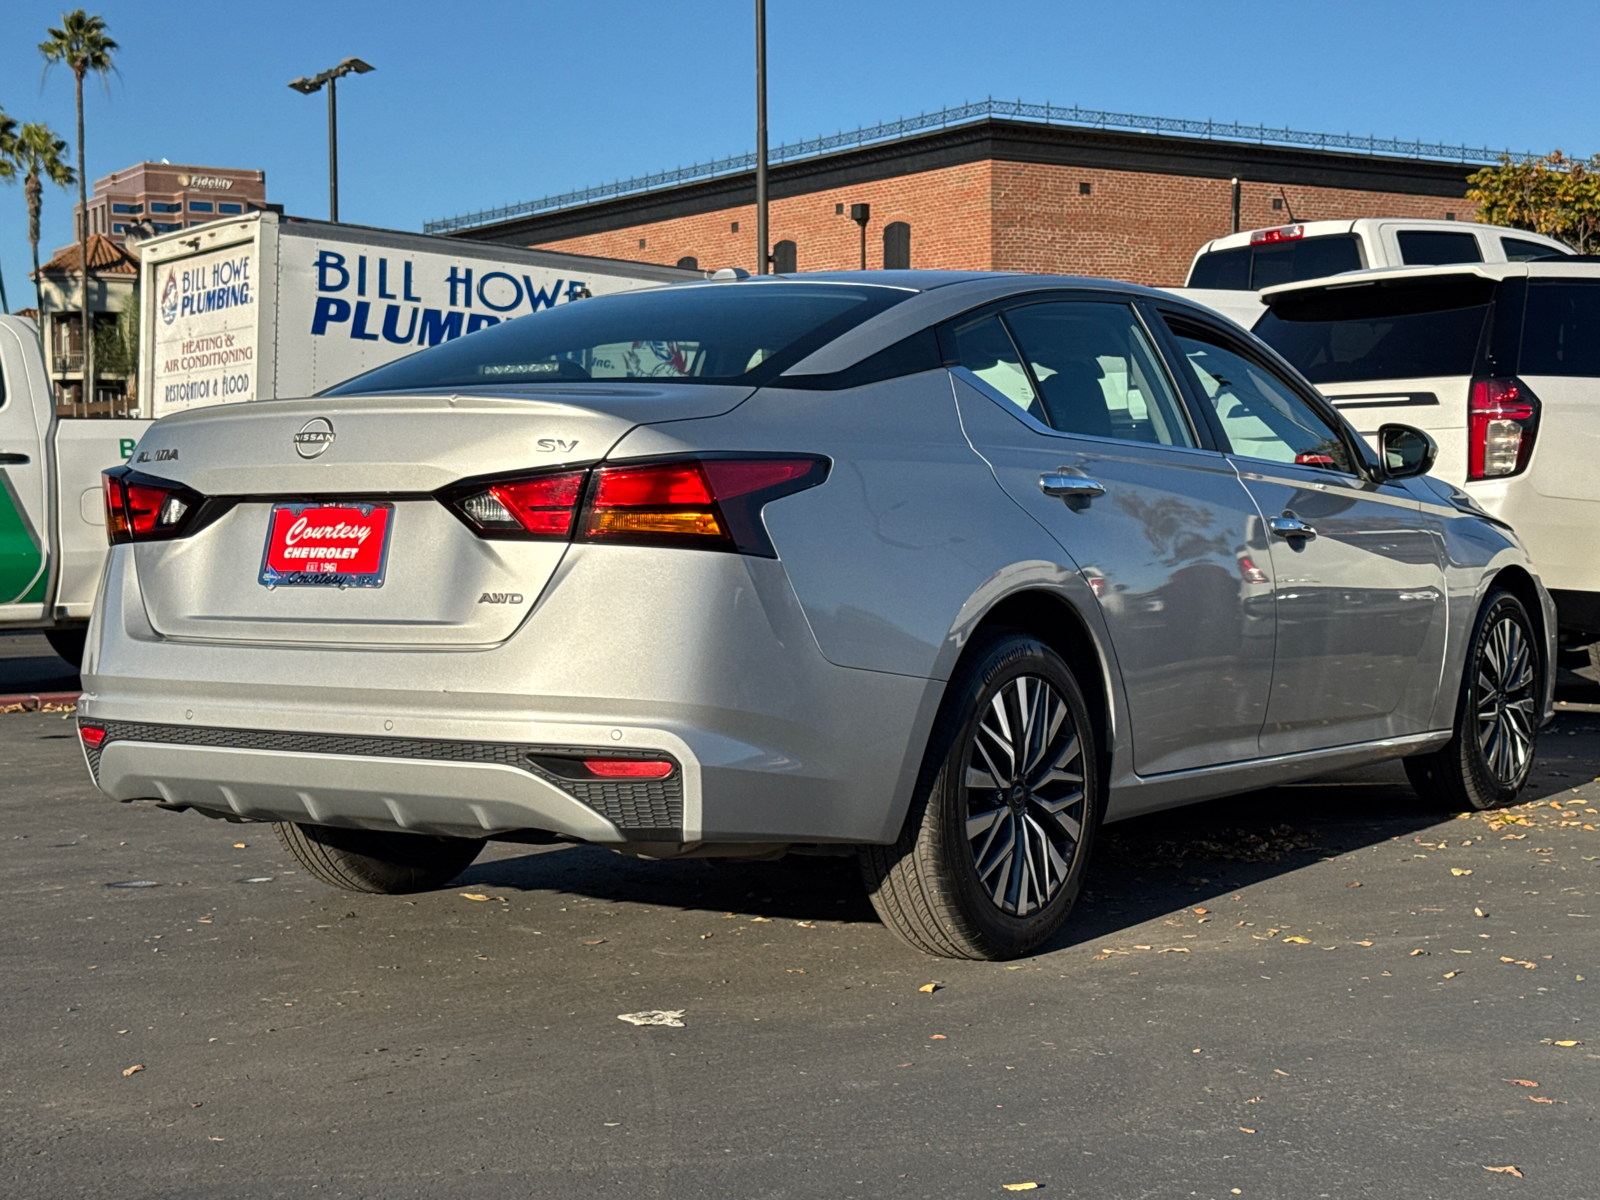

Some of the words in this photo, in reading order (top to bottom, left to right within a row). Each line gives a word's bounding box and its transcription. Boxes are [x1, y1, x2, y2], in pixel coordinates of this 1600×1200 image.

[190, 176, 234, 190] Fidelity
[182, 266, 207, 294] BILL
[212, 256, 250, 287] HOWE
[312, 250, 422, 303] BILL
[181, 281, 250, 318] PLUMBING
[181, 335, 223, 355] HEATING
[224, 333, 235, 348] &
[163, 359, 180, 373] AIR
[181, 346, 253, 371] CONDITIONING
[165, 379, 211, 403] RESTORATION
[222, 373, 249, 397] FLOOD
[294, 433, 335, 443] NISSAN
[536, 438, 580, 453] SV
[285, 516, 372, 546] Courtesy
[283, 547, 359, 559] CHEVROLET
[319, 562, 338, 573] 1961
[287, 571, 348, 588] Courtesy
[478, 592, 524, 604] AWD
[982, 643, 1028, 686] Continental
